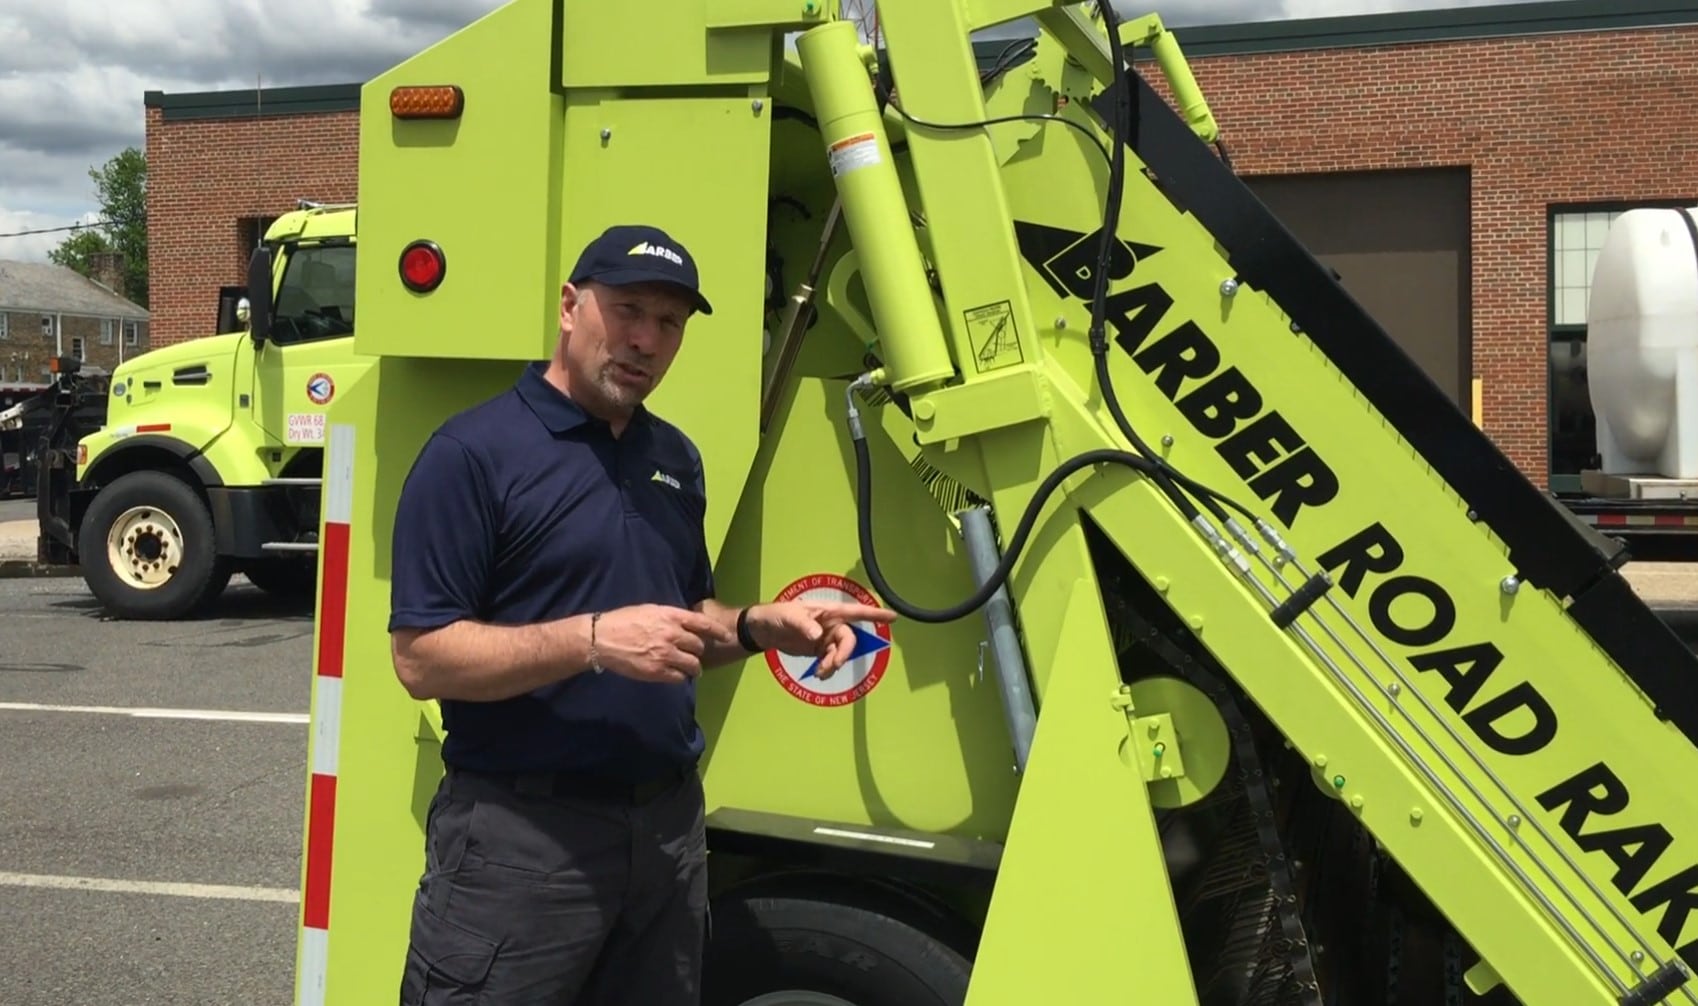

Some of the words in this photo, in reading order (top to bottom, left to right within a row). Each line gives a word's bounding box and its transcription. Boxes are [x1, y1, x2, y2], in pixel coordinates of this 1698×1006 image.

[811, 577, 822, 586] OF
[1043, 226, 1339, 530] BARBER
[1315, 521, 1558, 756] ROAD
[1535, 761, 1698, 978] RAK
[774, 667, 786, 684] THE
[787, 683, 811, 701] STATE
[815, 696, 825, 705] OF
[830, 696, 849, 705] NEW
[852, 674, 878, 700] JERSEY
